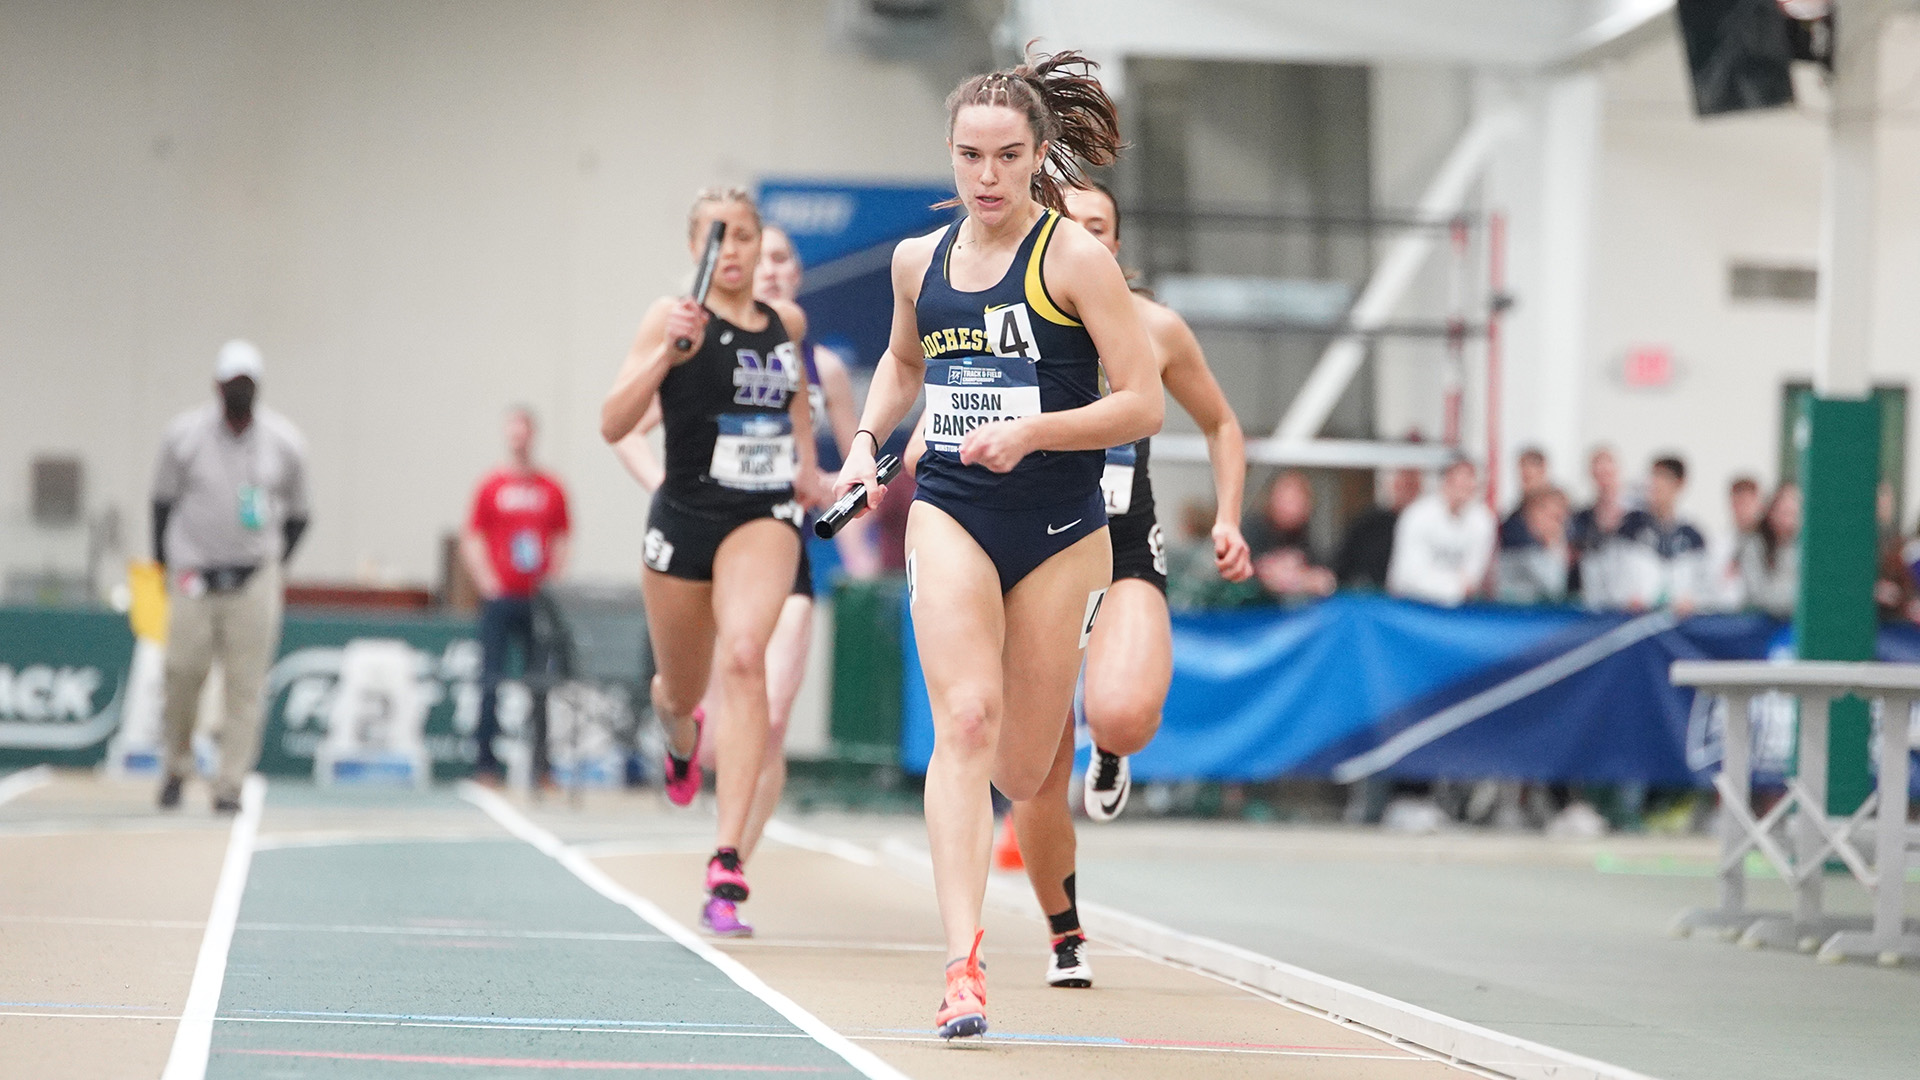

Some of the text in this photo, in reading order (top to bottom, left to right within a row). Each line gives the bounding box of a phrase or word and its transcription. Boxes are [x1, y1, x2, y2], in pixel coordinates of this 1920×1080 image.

[999, 310, 1029, 358] 4
[963, 370, 982, 378] TRACK
[951, 392, 1002, 411] SUSAN
[933, 413, 1021, 437] BANS
